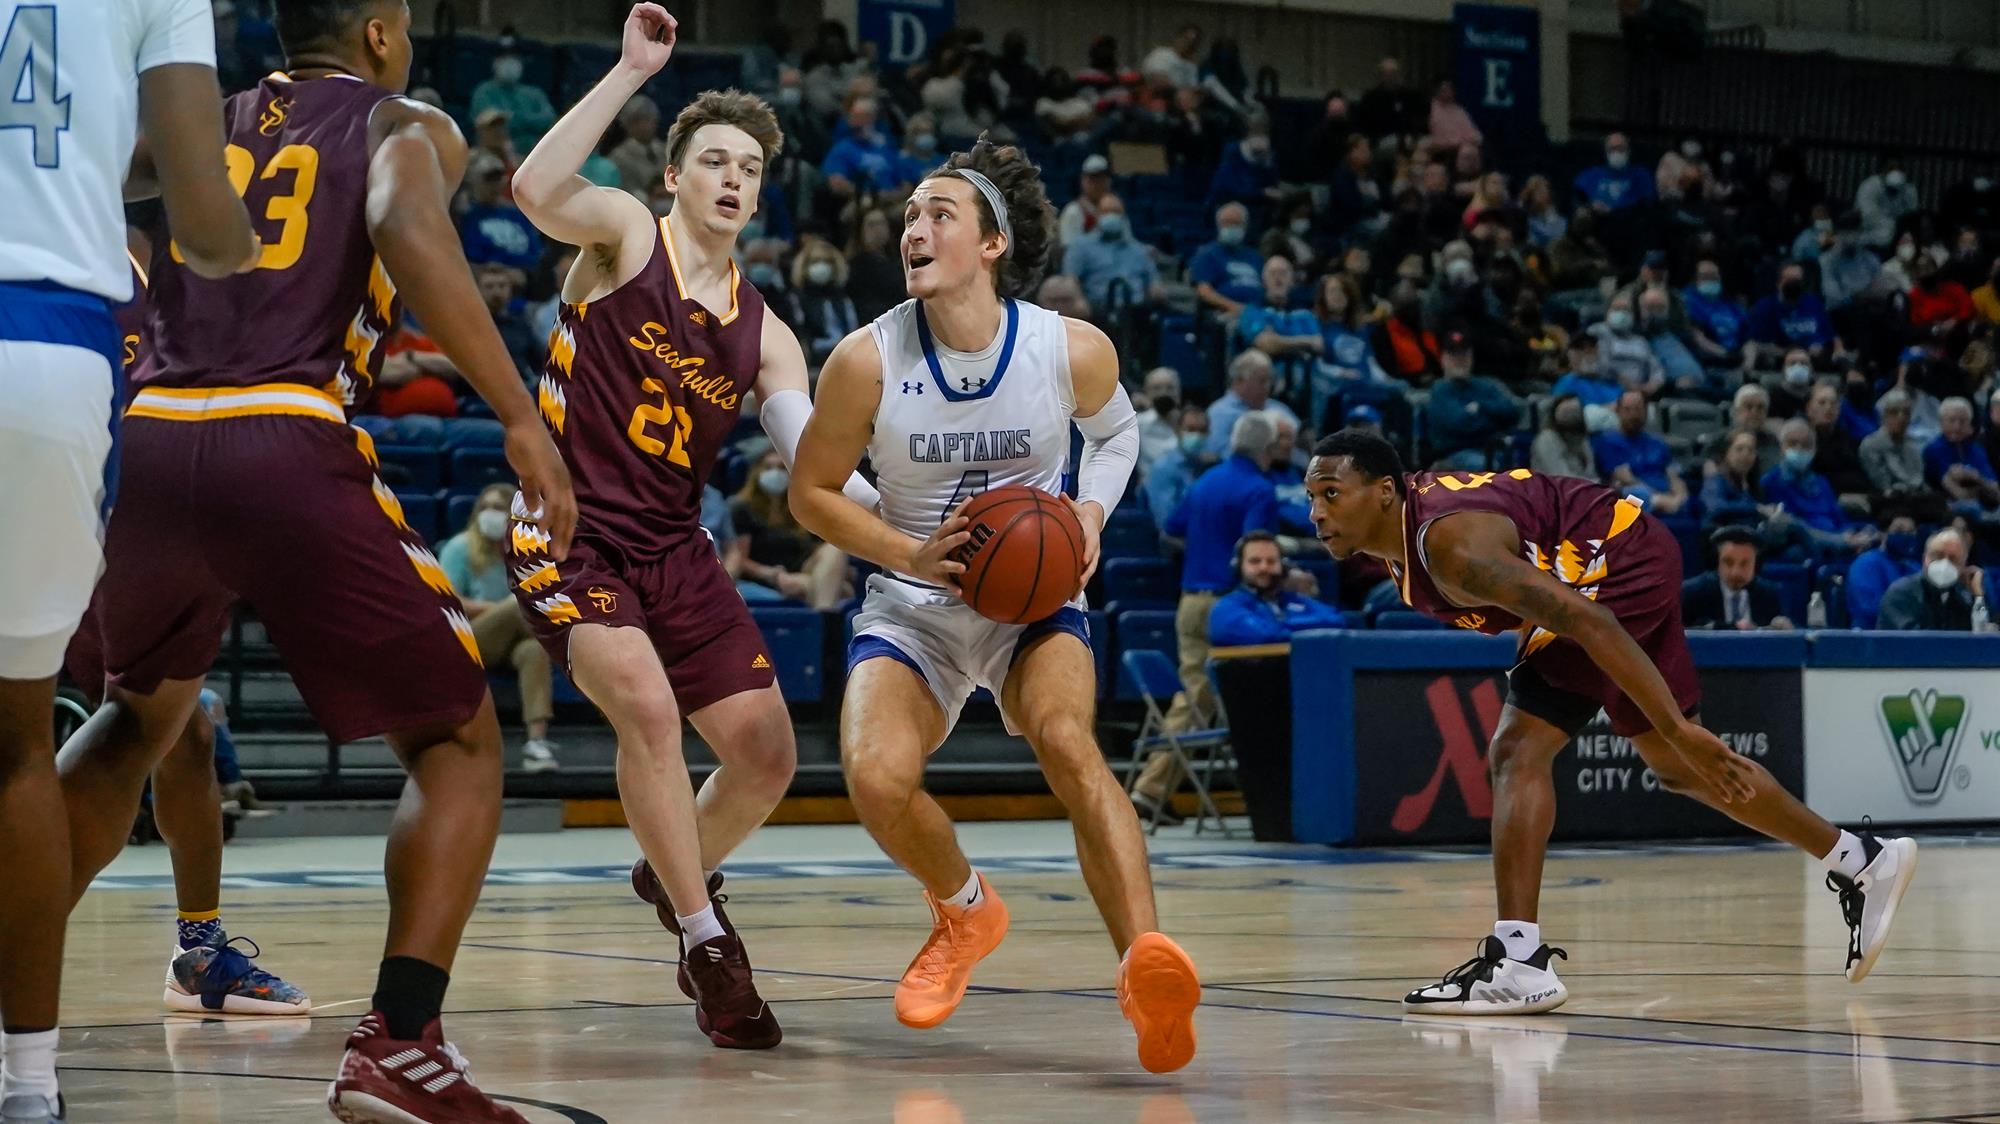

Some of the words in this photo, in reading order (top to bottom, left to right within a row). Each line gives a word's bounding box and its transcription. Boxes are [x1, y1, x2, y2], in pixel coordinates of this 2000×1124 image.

[888, 11, 927, 62] D
[0, 5, 71, 168] 4
[1482, 59, 1515, 107] E
[170, 143, 319, 270] 3
[627, 377, 693, 469] 22
[909, 429, 1031, 463] CAPTAINS
[1577, 768, 1632, 793] CITY
